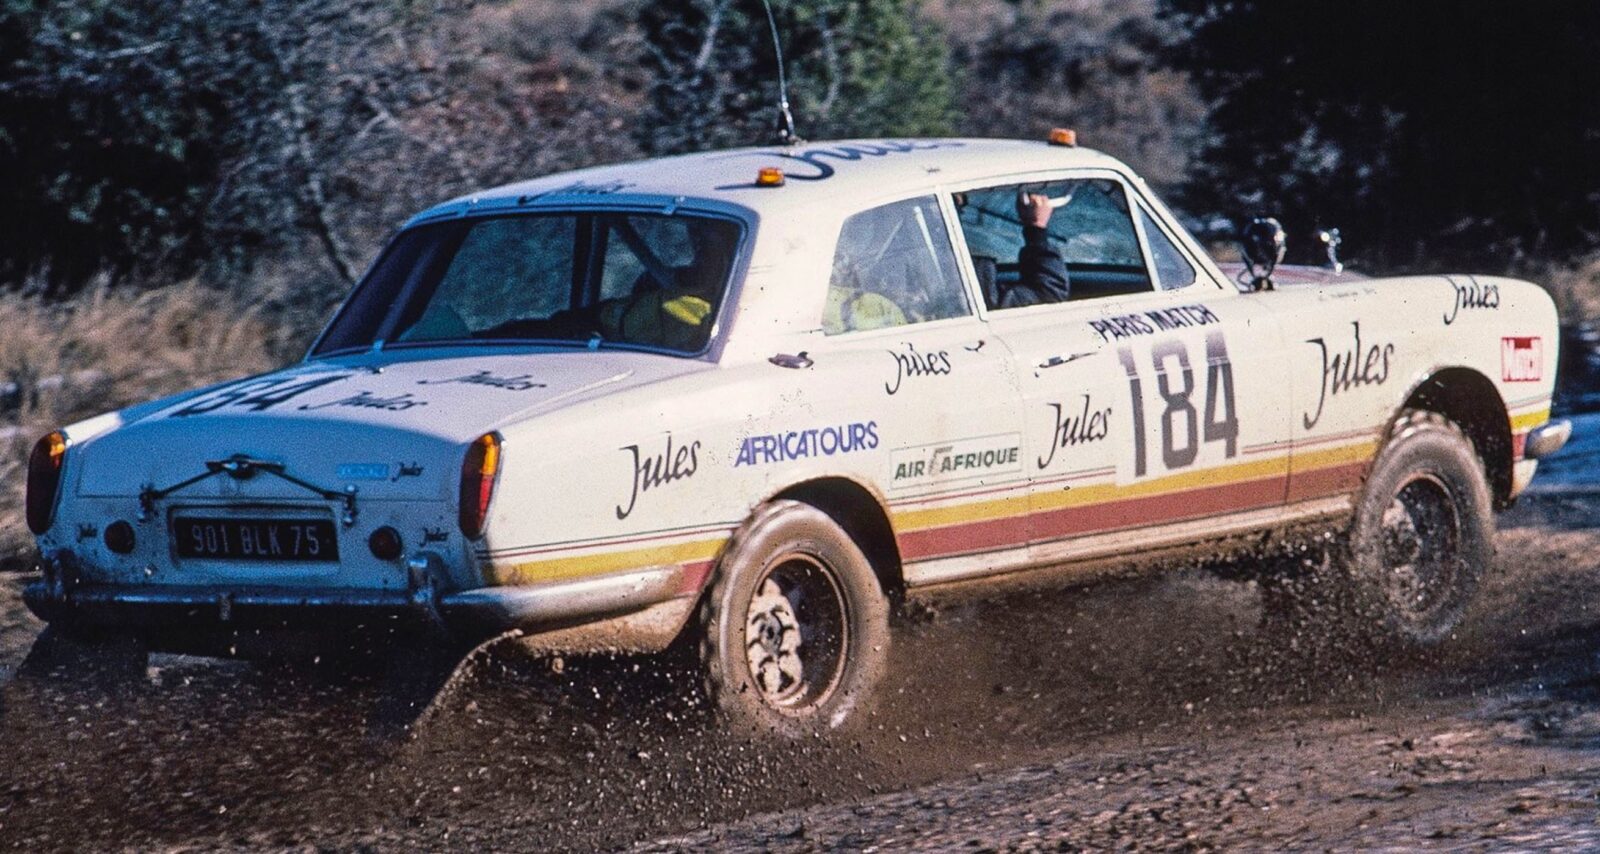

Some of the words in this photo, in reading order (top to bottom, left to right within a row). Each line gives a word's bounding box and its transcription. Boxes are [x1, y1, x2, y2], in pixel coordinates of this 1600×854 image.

[1088, 313, 1154, 343] PARIS
[1144, 303, 1220, 332] MATCH
[1443, 275, 1500, 325] Jules
[885, 342, 952, 395] Jules
[1303, 320, 1394, 430] Jules
[1117, 327, 1239, 477] 184
[734, 420, 880, 468] AFRICATOURS
[1037, 394, 1112, 470] Jules
[616, 431, 701, 520] Jules
[894, 459, 926, 480] AIR
[940, 446, 1019, 473] AFRIQUE
[191, 524, 229, 551] 901
[240, 525, 281, 555] BLK
[290, 525, 320, 555] 75
